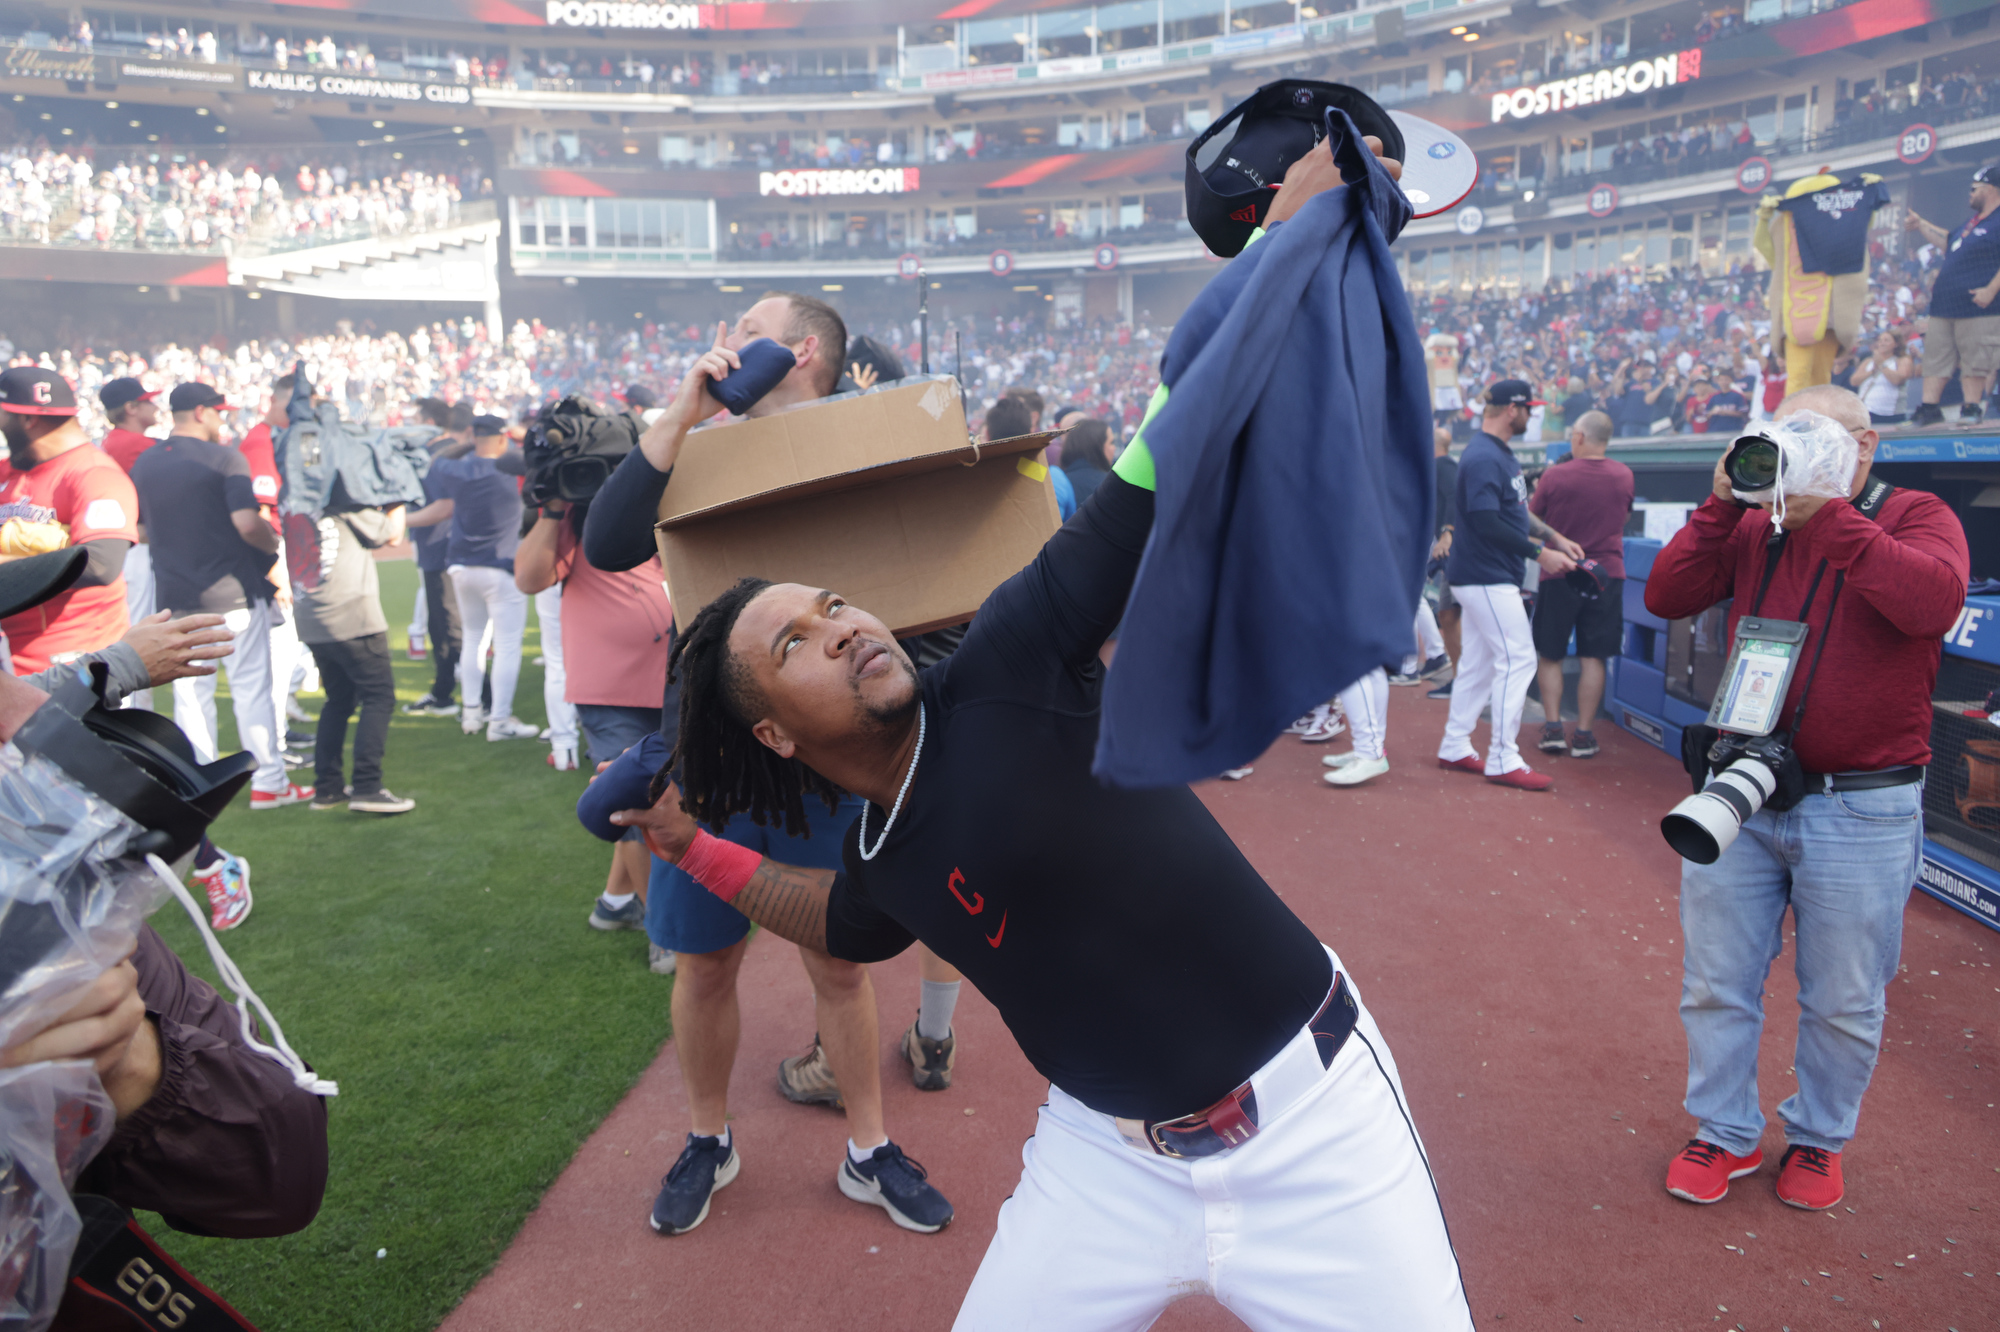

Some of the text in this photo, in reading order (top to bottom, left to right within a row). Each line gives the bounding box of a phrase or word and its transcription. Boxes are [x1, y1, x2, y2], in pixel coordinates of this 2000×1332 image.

[546, 0, 699, 29] POSTSEASON
[248, 70, 470, 103] KAULIG COMPANIES CLUB
[1491, 54, 1678, 123] POSTSEASON
[1902, 132, 1930, 156] 20
[759, 168, 904, 196] POSTSEASON
[33, 381, 52, 405] C
[1861, 482, 1887, 510] Canon
[947, 866, 984, 916] C
[1922, 862, 1997, 917] GUARDIANS.COM
[1223, 1122, 1250, 1145] 11
[116, 1256, 196, 1329] EOS
